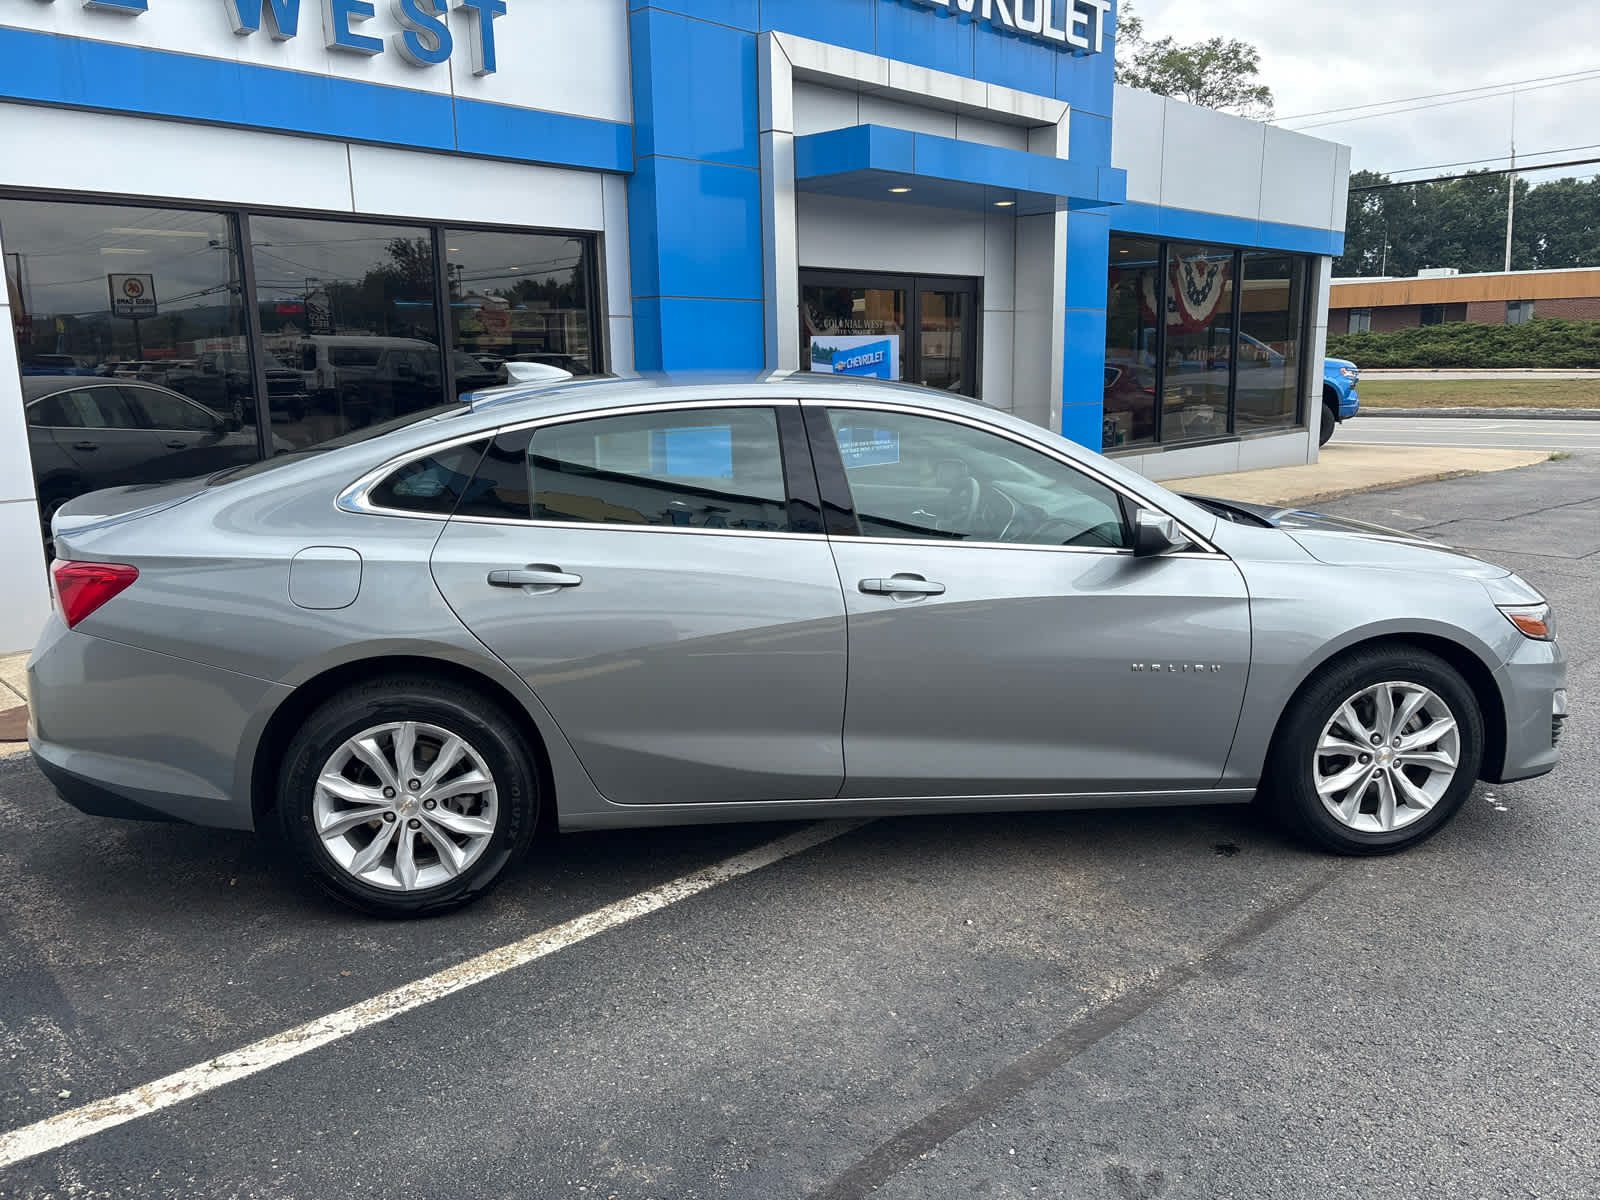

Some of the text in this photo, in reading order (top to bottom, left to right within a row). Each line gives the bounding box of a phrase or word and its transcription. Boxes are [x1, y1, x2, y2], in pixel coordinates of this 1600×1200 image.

[929, 0, 1111, 53] OLET
[823, 319, 884, 329] COLONIAL WEST
[846, 351, 884, 369] CHEVROLET
[1131, 663, 1222, 673] MALIBU
